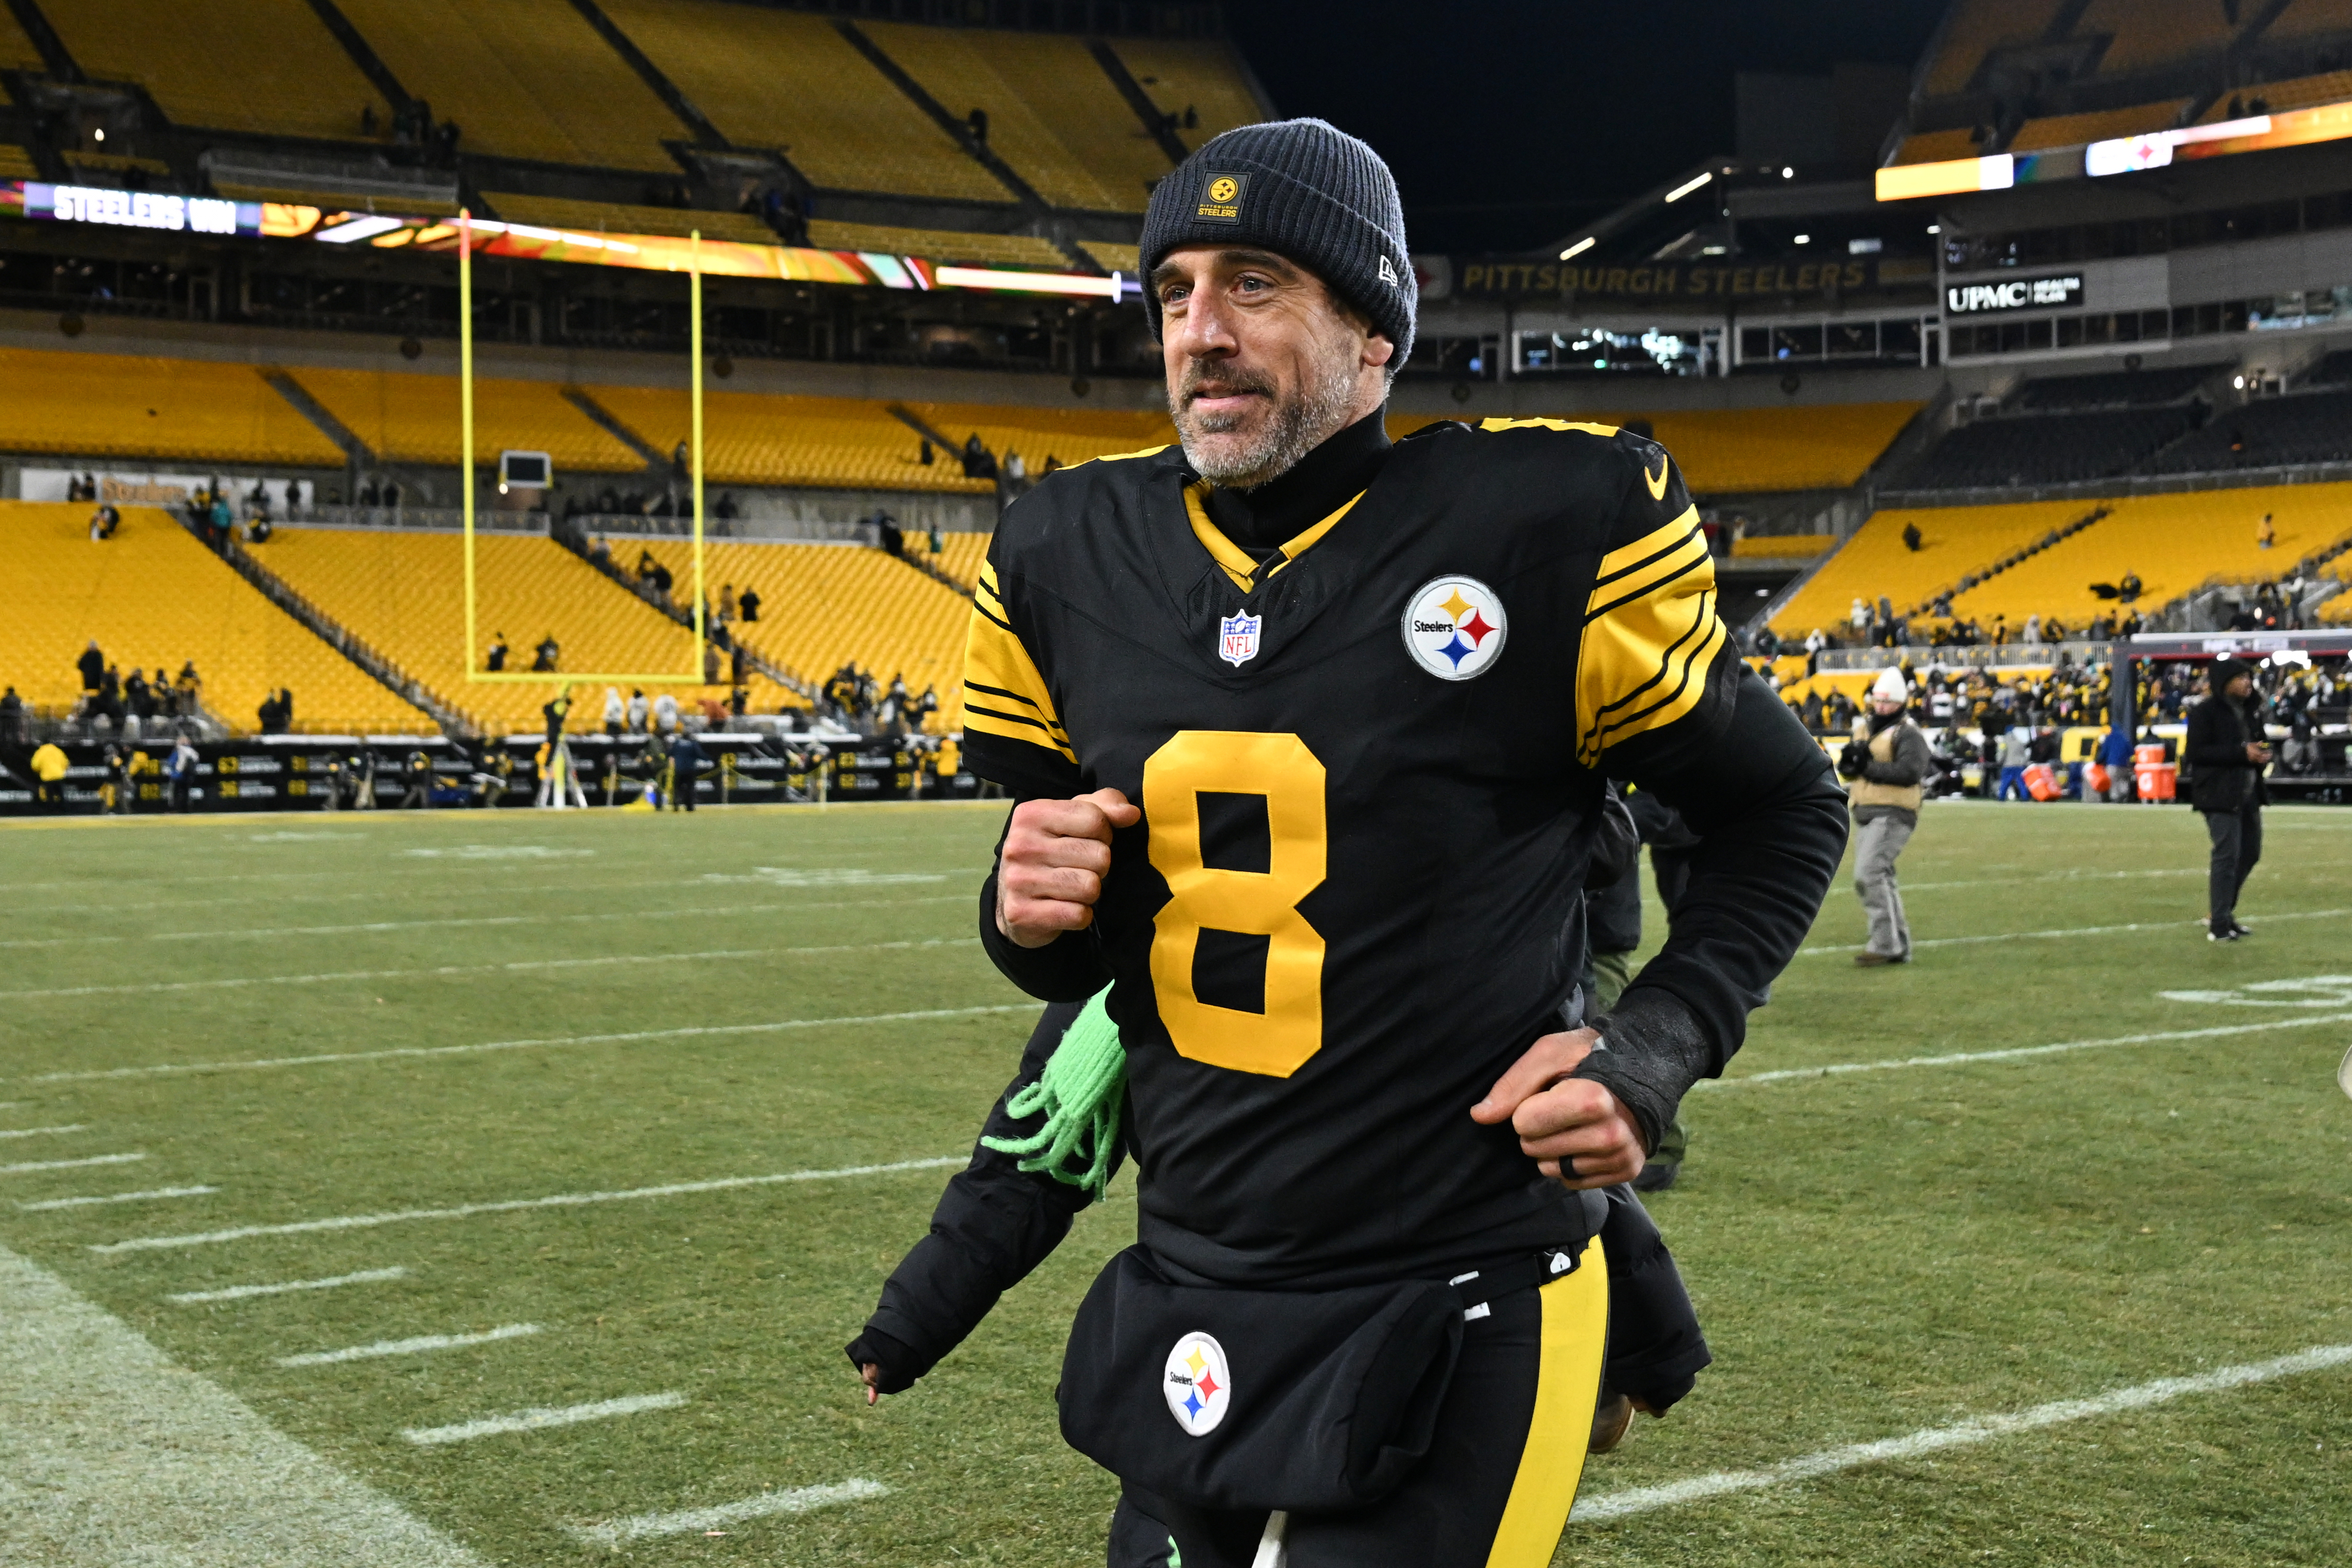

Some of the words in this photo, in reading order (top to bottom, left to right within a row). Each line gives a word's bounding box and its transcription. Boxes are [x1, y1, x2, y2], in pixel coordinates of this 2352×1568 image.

[54, 186, 184, 230] STEELERS
[1198, 208, 1237, 217] STEELERS
[1463, 265, 1677, 294] PITTSBURGH
[1687, 262, 1866, 294] STEELERS
[1948, 282, 2026, 313] UPMC
[1414, 620, 1454, 632] Steelers
[1225, 636, 1252, 656] NFL
[1142, 730, 1327, 1078] 8
[1170, 1371, 1193, 1386] Steelers
